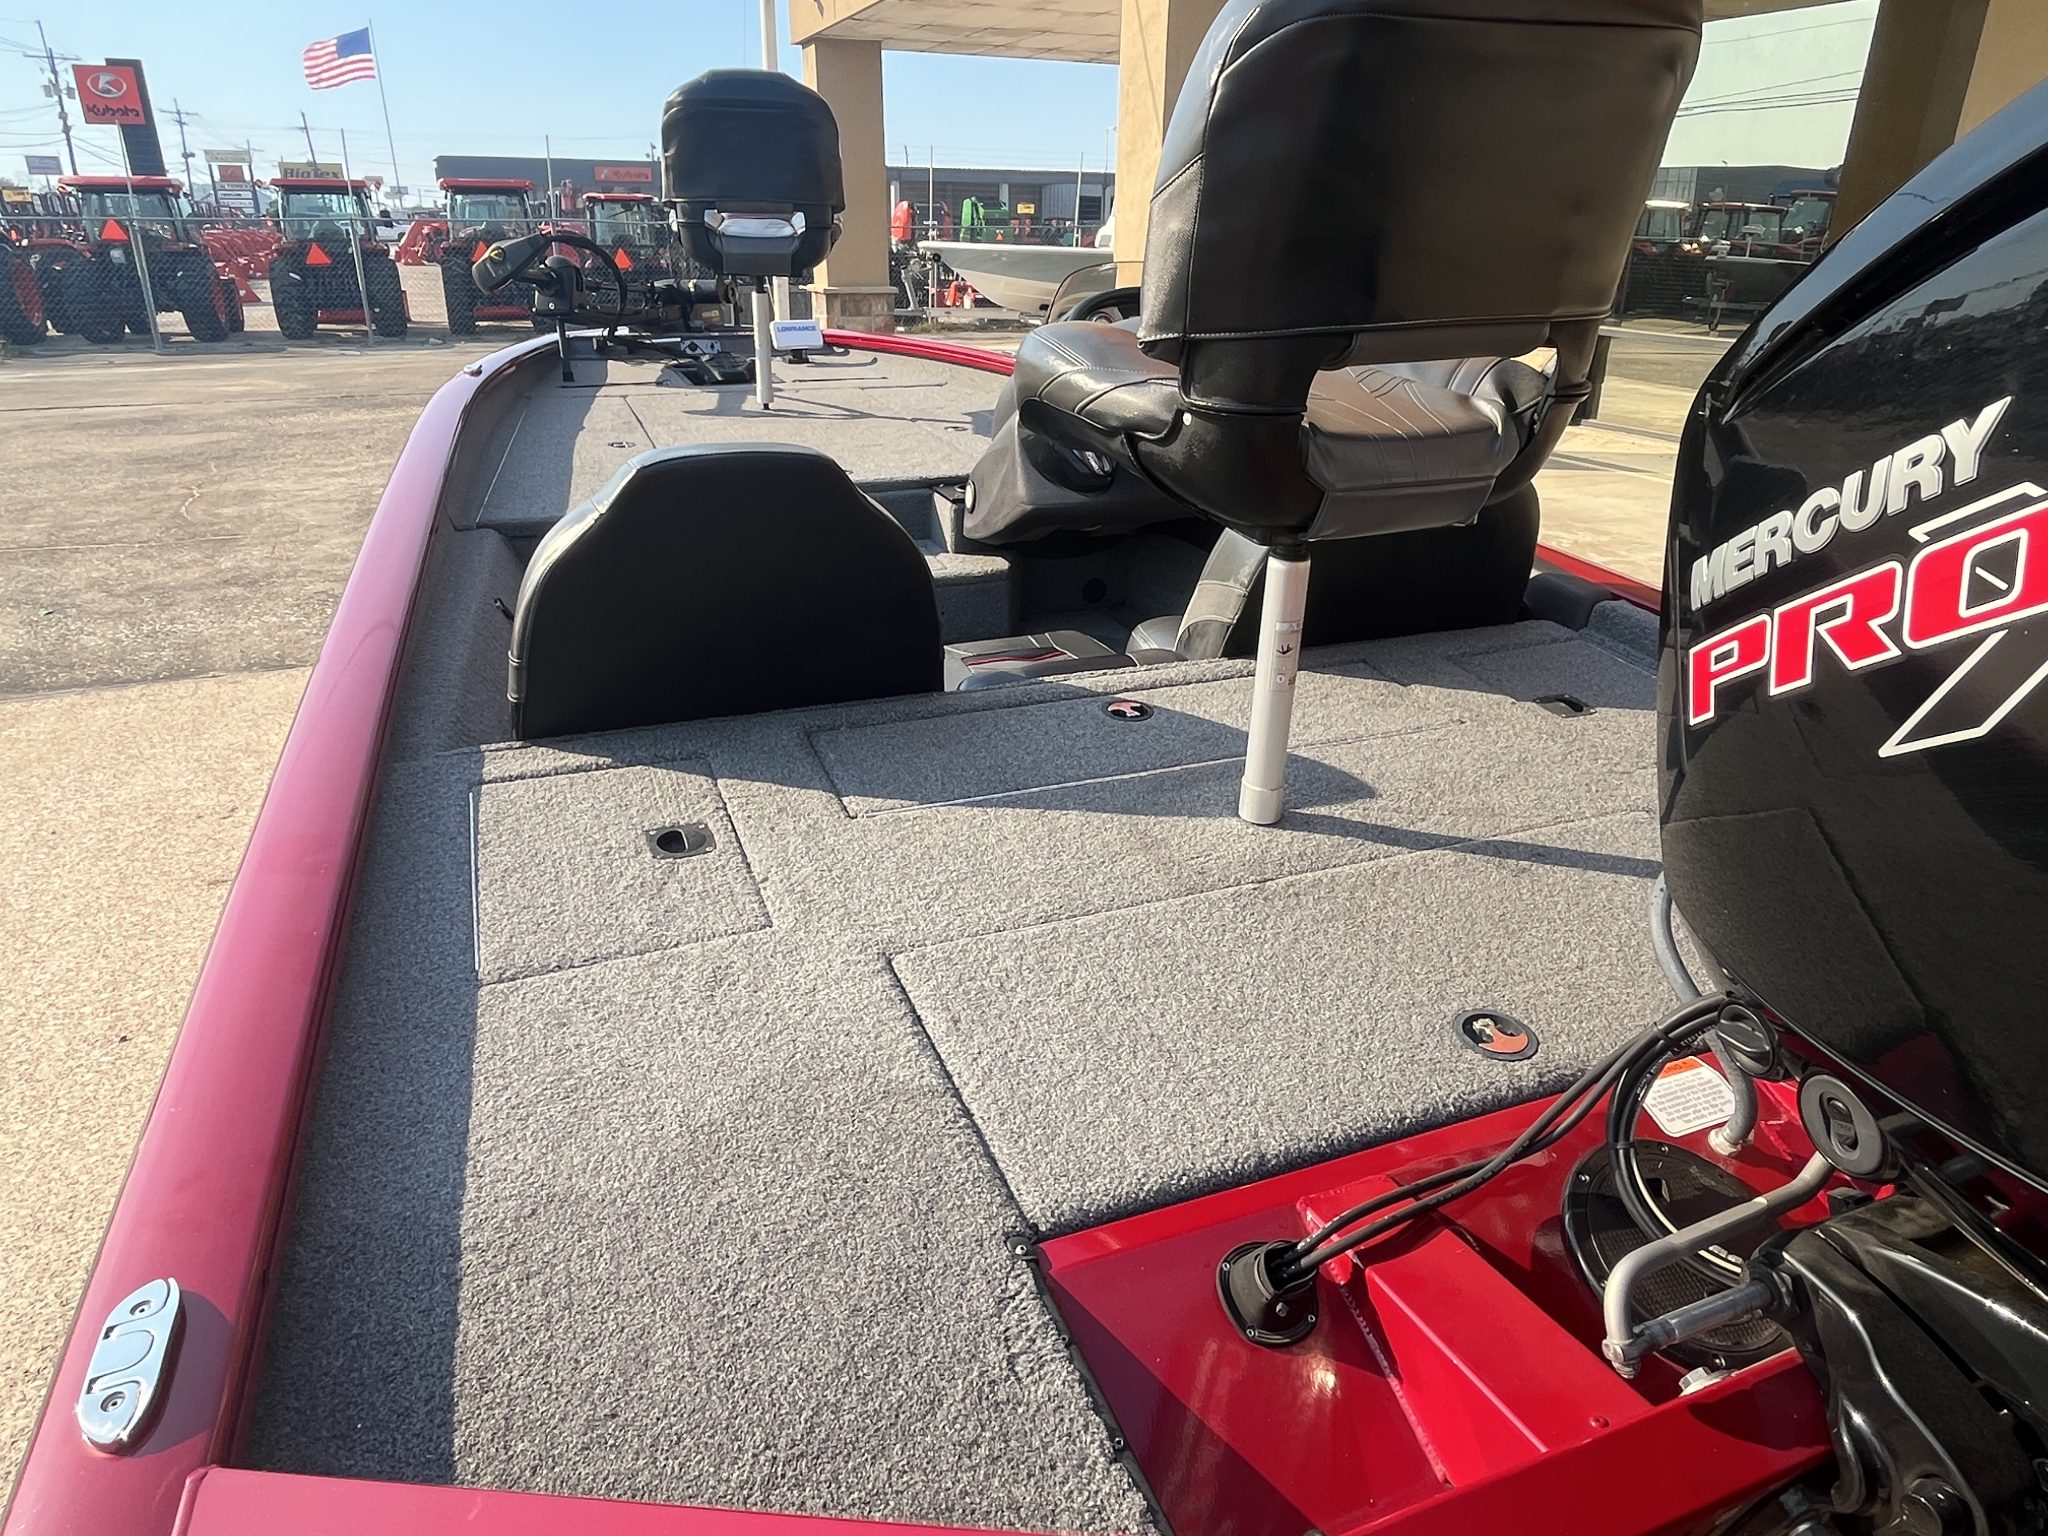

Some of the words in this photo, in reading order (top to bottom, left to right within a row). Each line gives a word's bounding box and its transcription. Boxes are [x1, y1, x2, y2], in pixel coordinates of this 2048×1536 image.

[86, 103, 140, 117] Kubota
[776, 325, 817, 333] LOWRANCE
[1691, 396, 2012, 612] MERCURY
